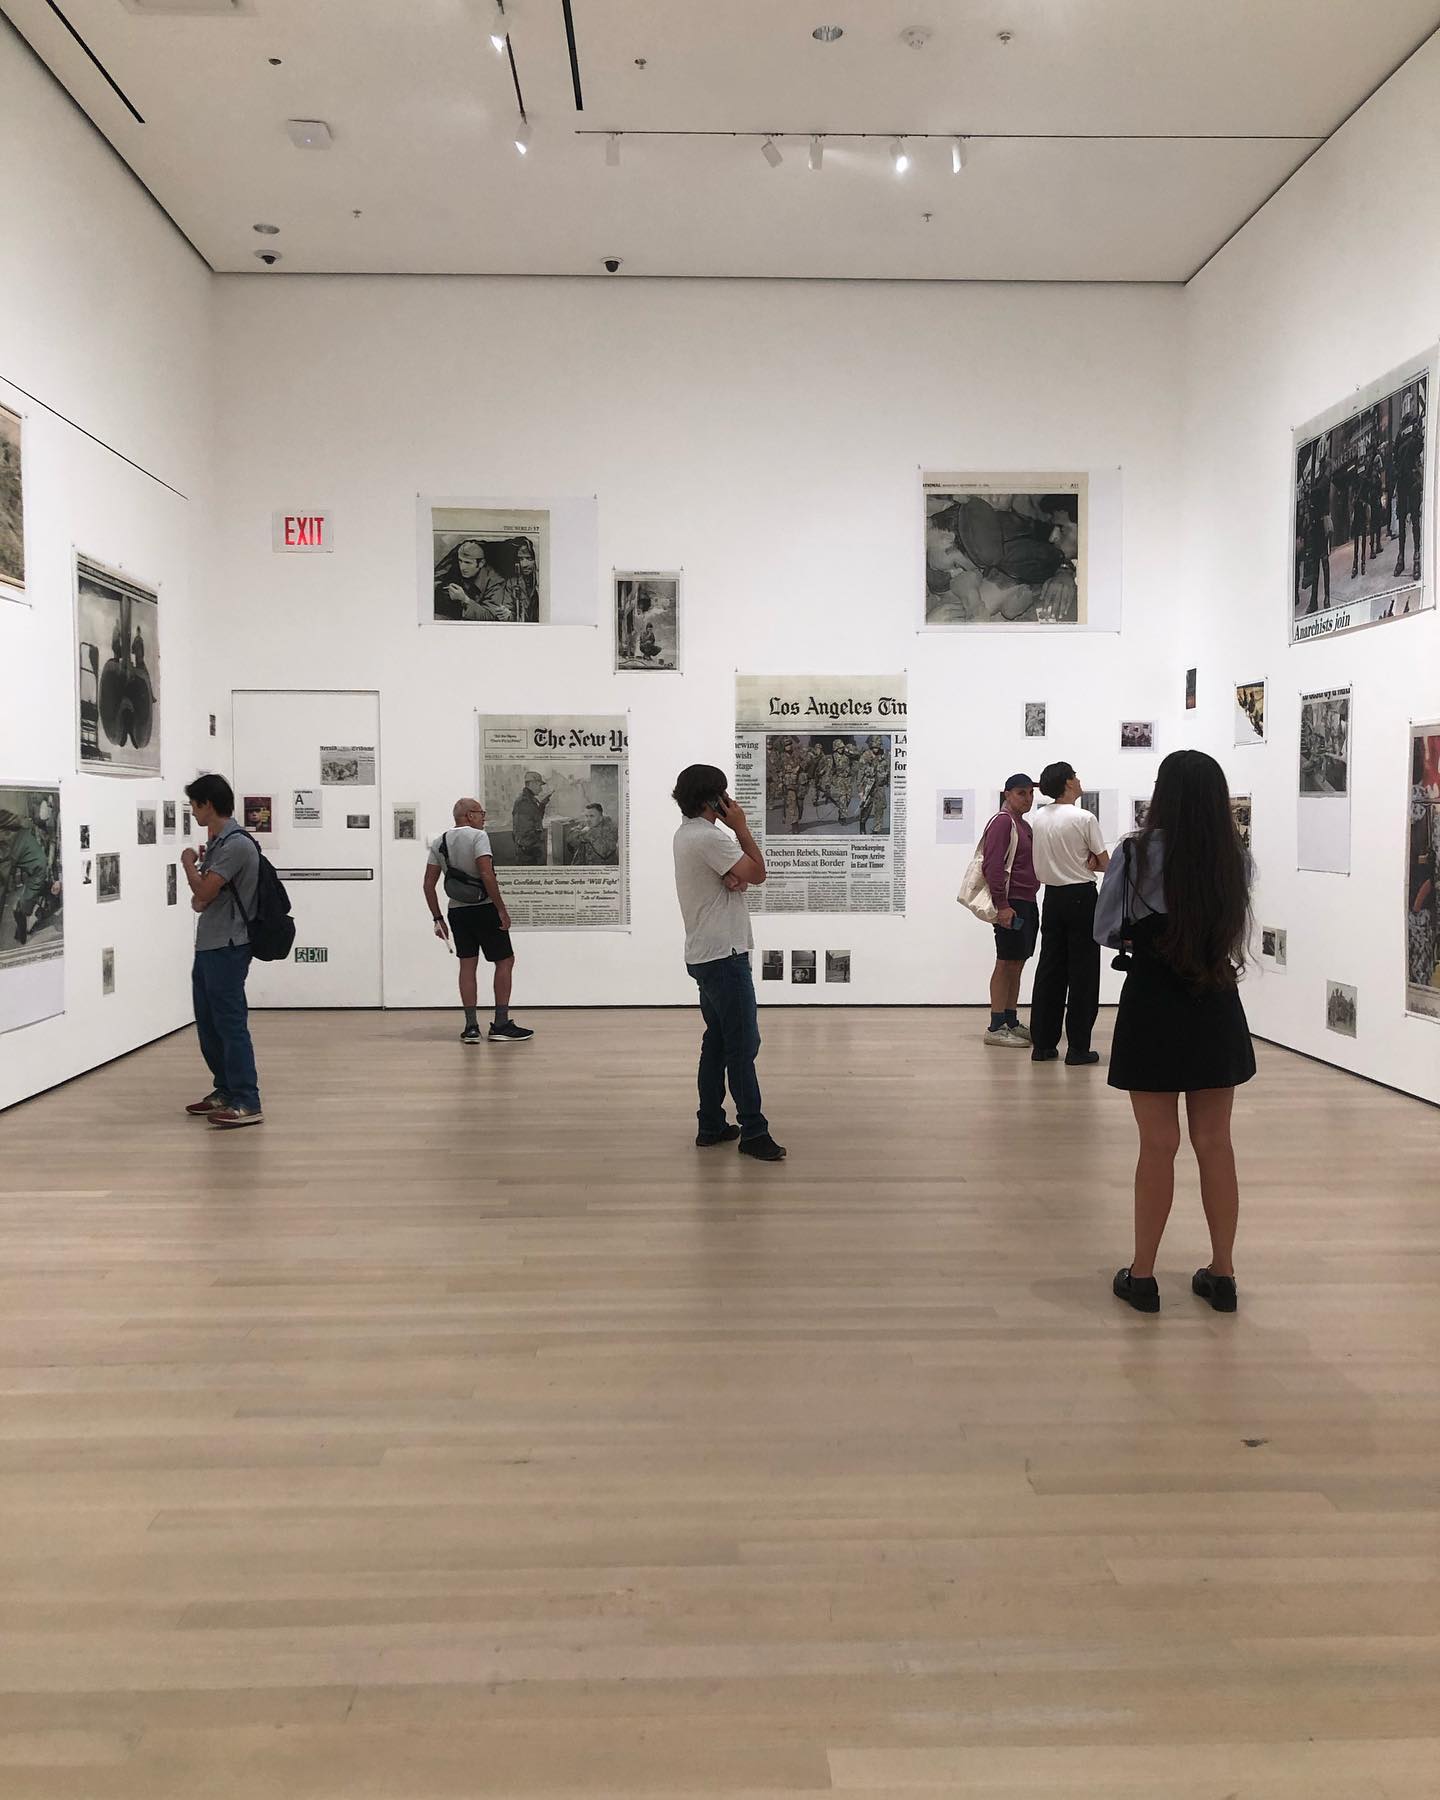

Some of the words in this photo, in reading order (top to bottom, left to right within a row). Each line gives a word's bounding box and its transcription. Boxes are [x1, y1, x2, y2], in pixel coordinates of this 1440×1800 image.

[285, 517, 324, 545] EXIT
[1295, 617, 1334, 640] Anarchists
[1334, 611, 1351, 632] join
[769, 697, 800, 716] Los
[804, 696, 873, 719] Angeles
[534, 728, 567, 749] The
[569, 729, 606, 748] New
[895, 761, 907, 770] for
[295, 794, 304, 805] A
[765, 848, 795, 857] Chechen
[797, 848, 820, 858] Rebels,
[821, 848, 848, 857] Russian
[851, 844, 885, 852] Peacekeeping
[851, 853, 868, 861] Troops
[766, 859, 791, 868] Troops
[793, 859, 810, 867] Mass
[820, 859, 846, 867] Border
[513, 879, 542, 887] Confident,
[308, 949, 327, 961] EXIT
